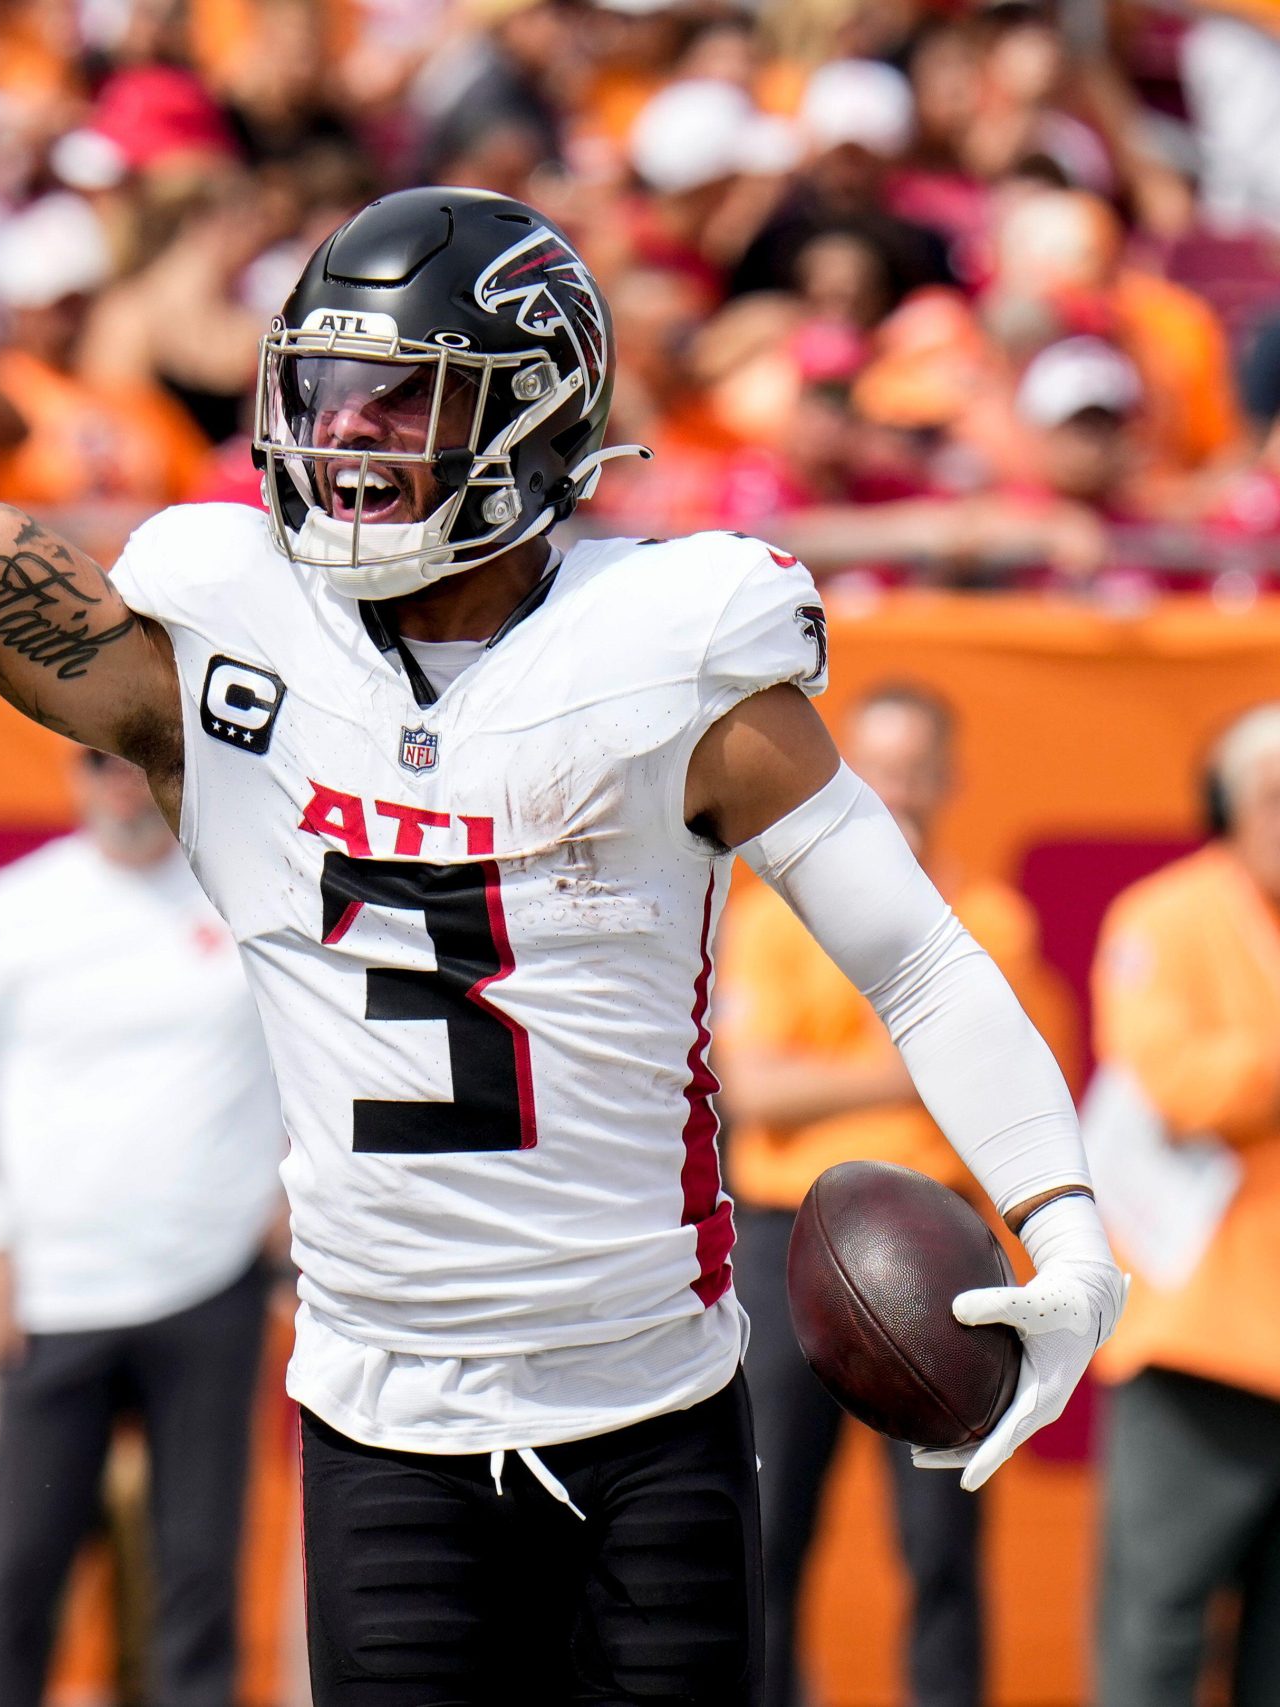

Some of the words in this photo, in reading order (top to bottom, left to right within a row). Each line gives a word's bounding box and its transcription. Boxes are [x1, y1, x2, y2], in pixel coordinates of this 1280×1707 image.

[319, 314, 368, 333] ATL
[207, 663, 277, 731] C
[405, 744, 433, 767] NFL
[320, 850, 538, 1153] 3
